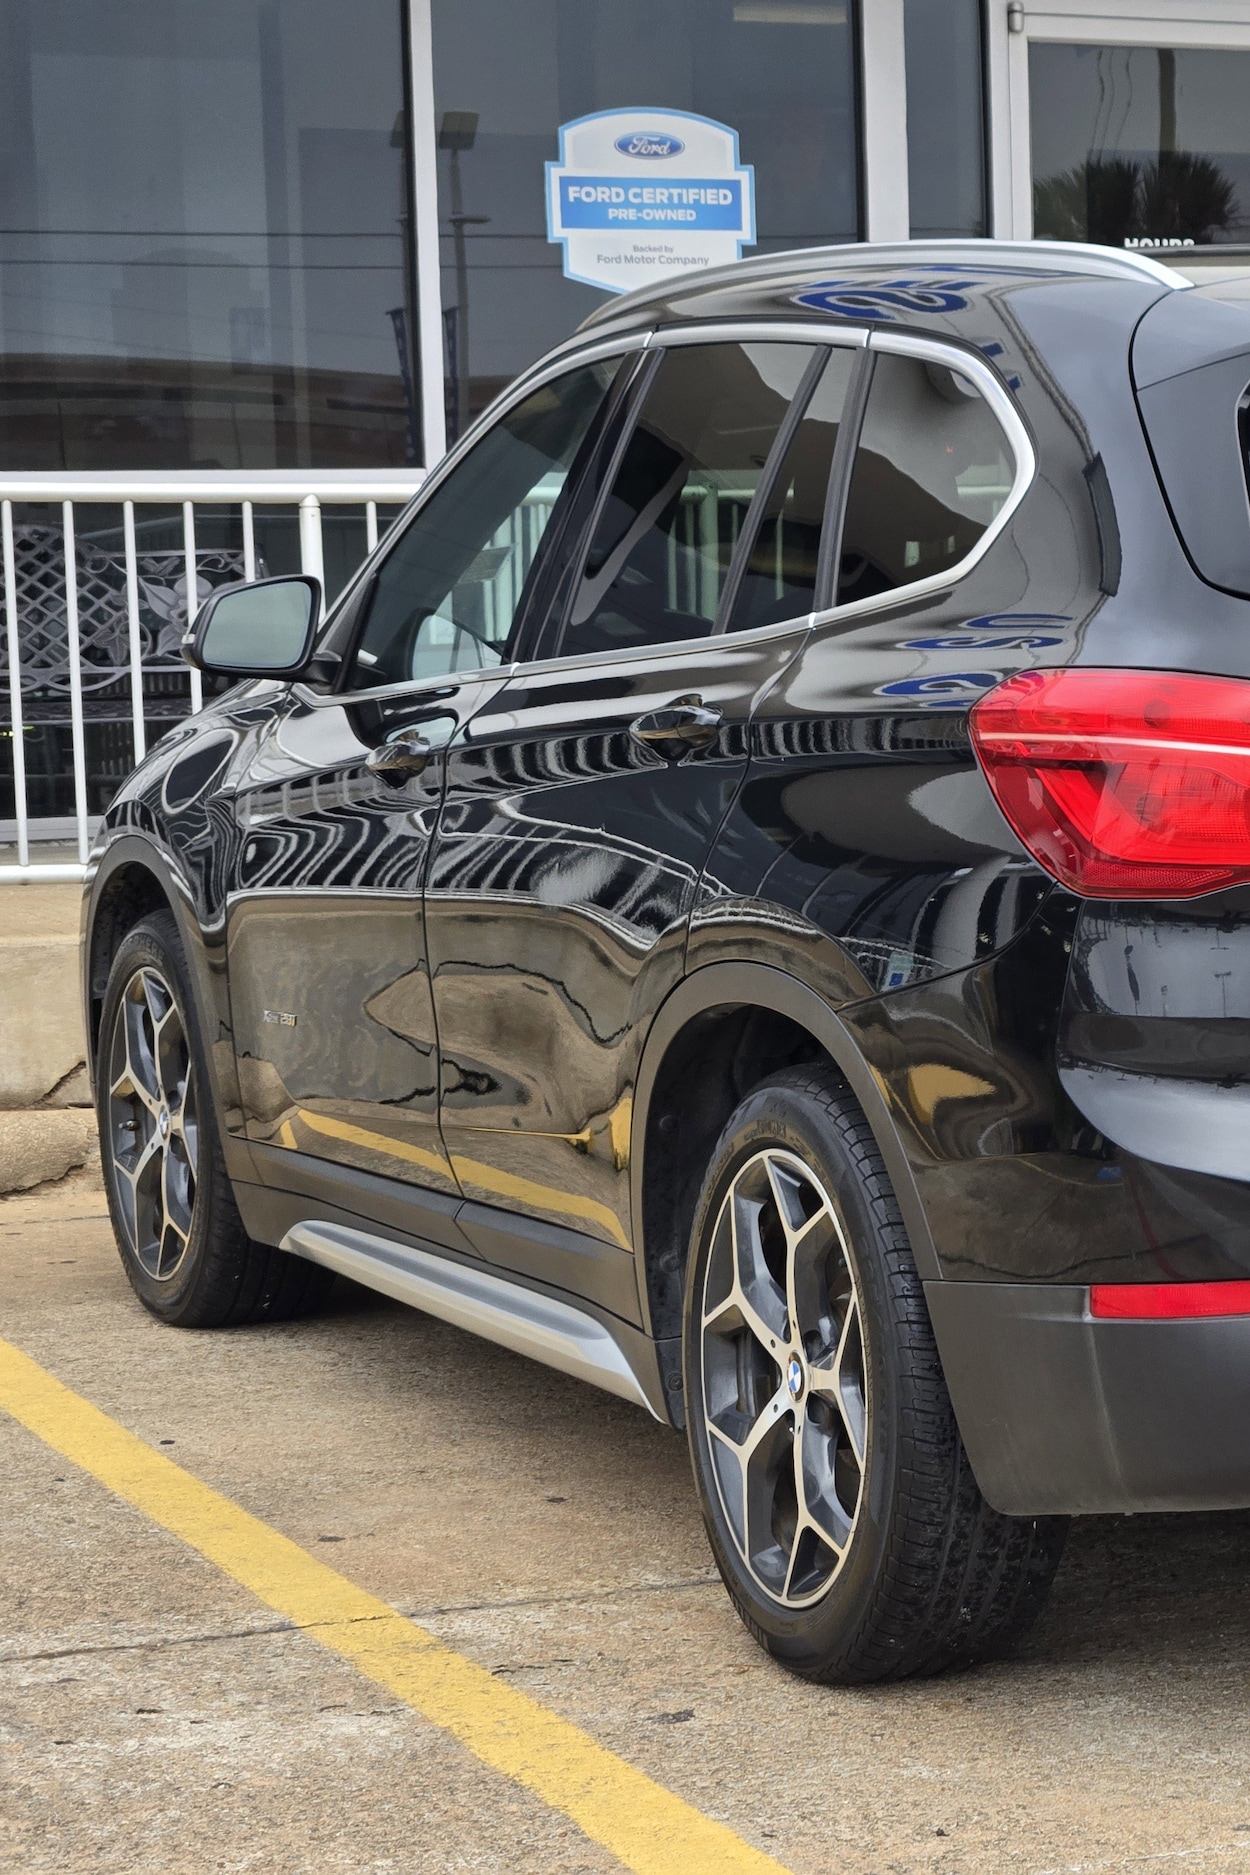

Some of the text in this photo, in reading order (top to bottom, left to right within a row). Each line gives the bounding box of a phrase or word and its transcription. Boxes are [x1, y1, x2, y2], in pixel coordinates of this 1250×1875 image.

[628, 136, 671, 155] Ford
[568, 185, 733, 205] FORD CERTIFIED
[608, 208, 697, 221] PRE-OWNED
[633, 244, 674, 254] Backed by
[597, 254, 709, 267] Ford Motor Company
